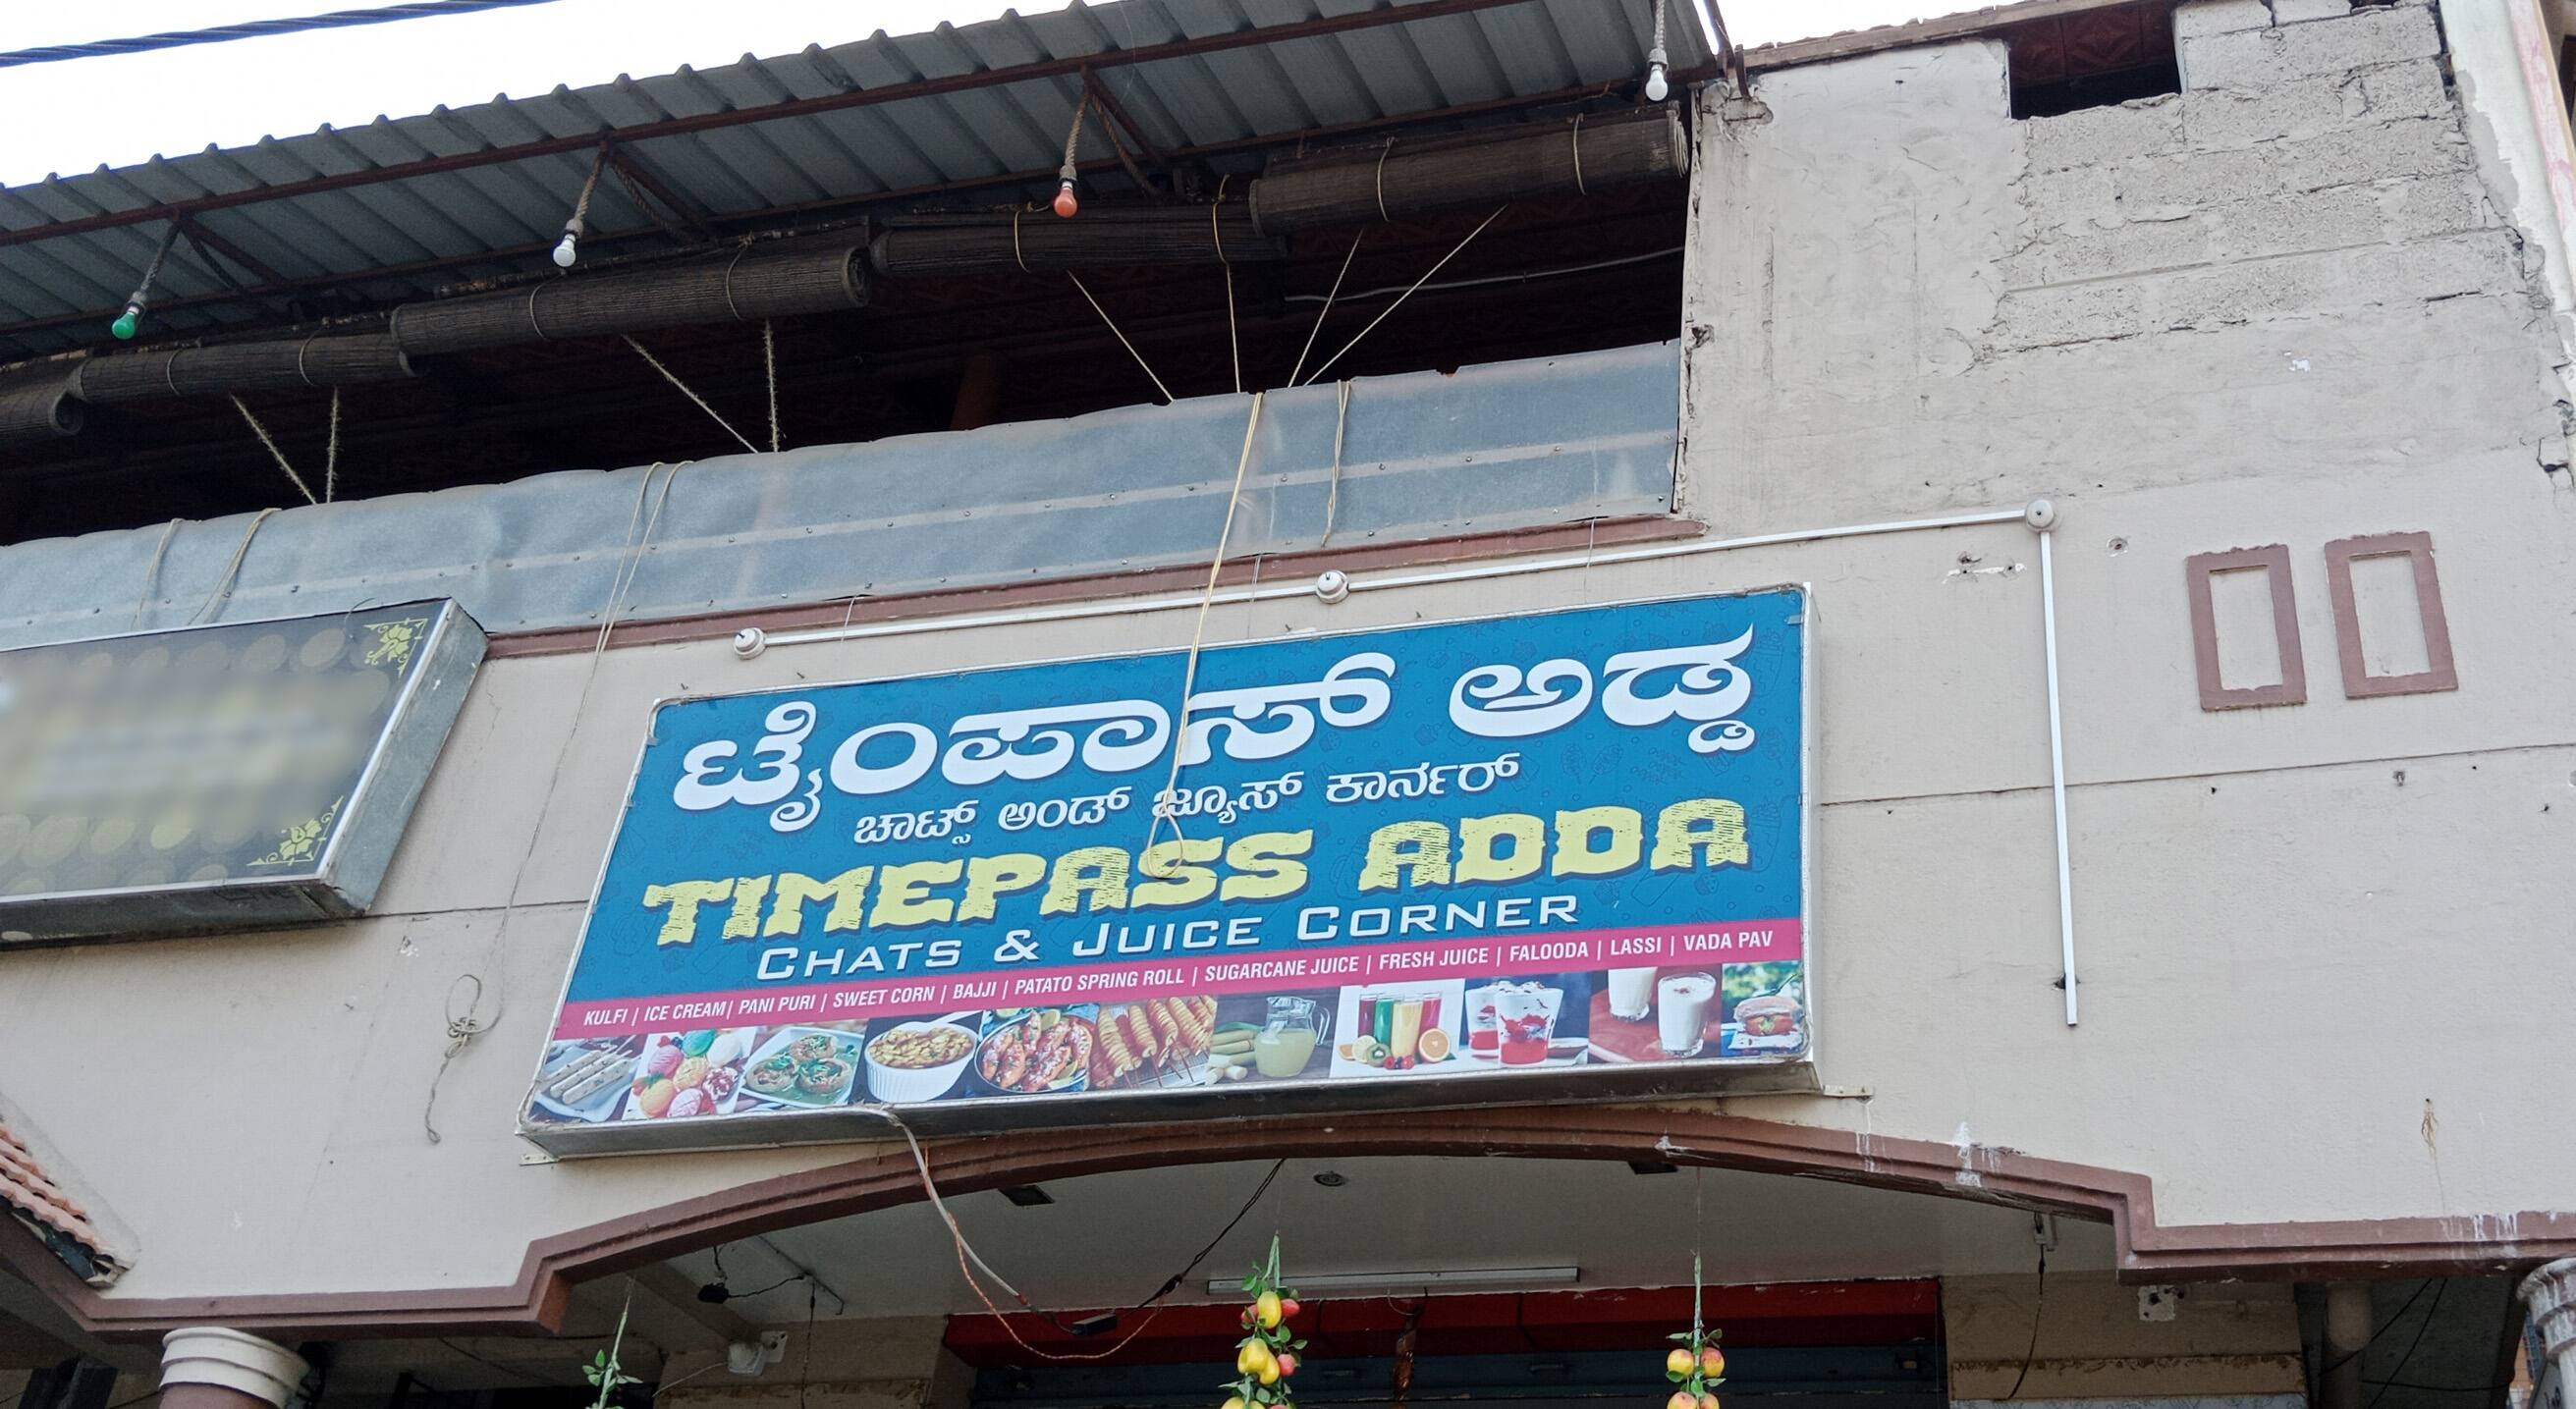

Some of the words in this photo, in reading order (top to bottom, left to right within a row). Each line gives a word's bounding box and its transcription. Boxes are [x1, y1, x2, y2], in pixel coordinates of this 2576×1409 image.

[674, 652, 1396, 833] ಟೈಂಪಾಸ್
[1449, 623, 1756, 754] ಅಡ್ಡ
[853, 799, 979, 845] ಚಾಟ್ಸ್
[998, 786, 1132, 831] ಅಂಡ್
[1152, 770, 1305, 825] ಜ್ಯೂಸ್
[1326, 752, 1521, 802] ಕಾರ್ನರ್
[643, 830, 1313, 947] TIMEPASS
[1358, 798, 1750, 891] ADDA
[583, 1007, 629, 1026] KULFI
[643, 1004, 671, 1021] ICE
[672, 1001, 728, 1019] CREAM
[739, 997, 776, 1014] PANI
[777, 994, 817, 1011] PURI
[833, 989, 889, 1007] SWEET
[891, 985, 936, 1003] CORN
[953, 981, 997, 1000] BAJJI
[1014, 976, 1074, 995] PATATO
[1076, 970, 1139, 990] SPRING
[1142, 967, 1184, 986] ROLL
[1204, 958, 1307, 982] SUGARCANE
[1310, 955, 1359, 975] JUICE
[1379, 949, 1435, 970] FRESH
[1439, 947, 1489, 966] JUICE
[1508, 941, 1589, 962] FALOODA
[1610, 936, 1662, 955] LASSI
[1683, 931, 1733, 951] VADA
[1738, 930, 1774, 948] PAV
[757, 940, 962, 981] CHATS
[994, 929, 1039, 962] &
[1072, 916, 1263, 956] JUICE
[1297, 894, 1578, 941] CORNER
